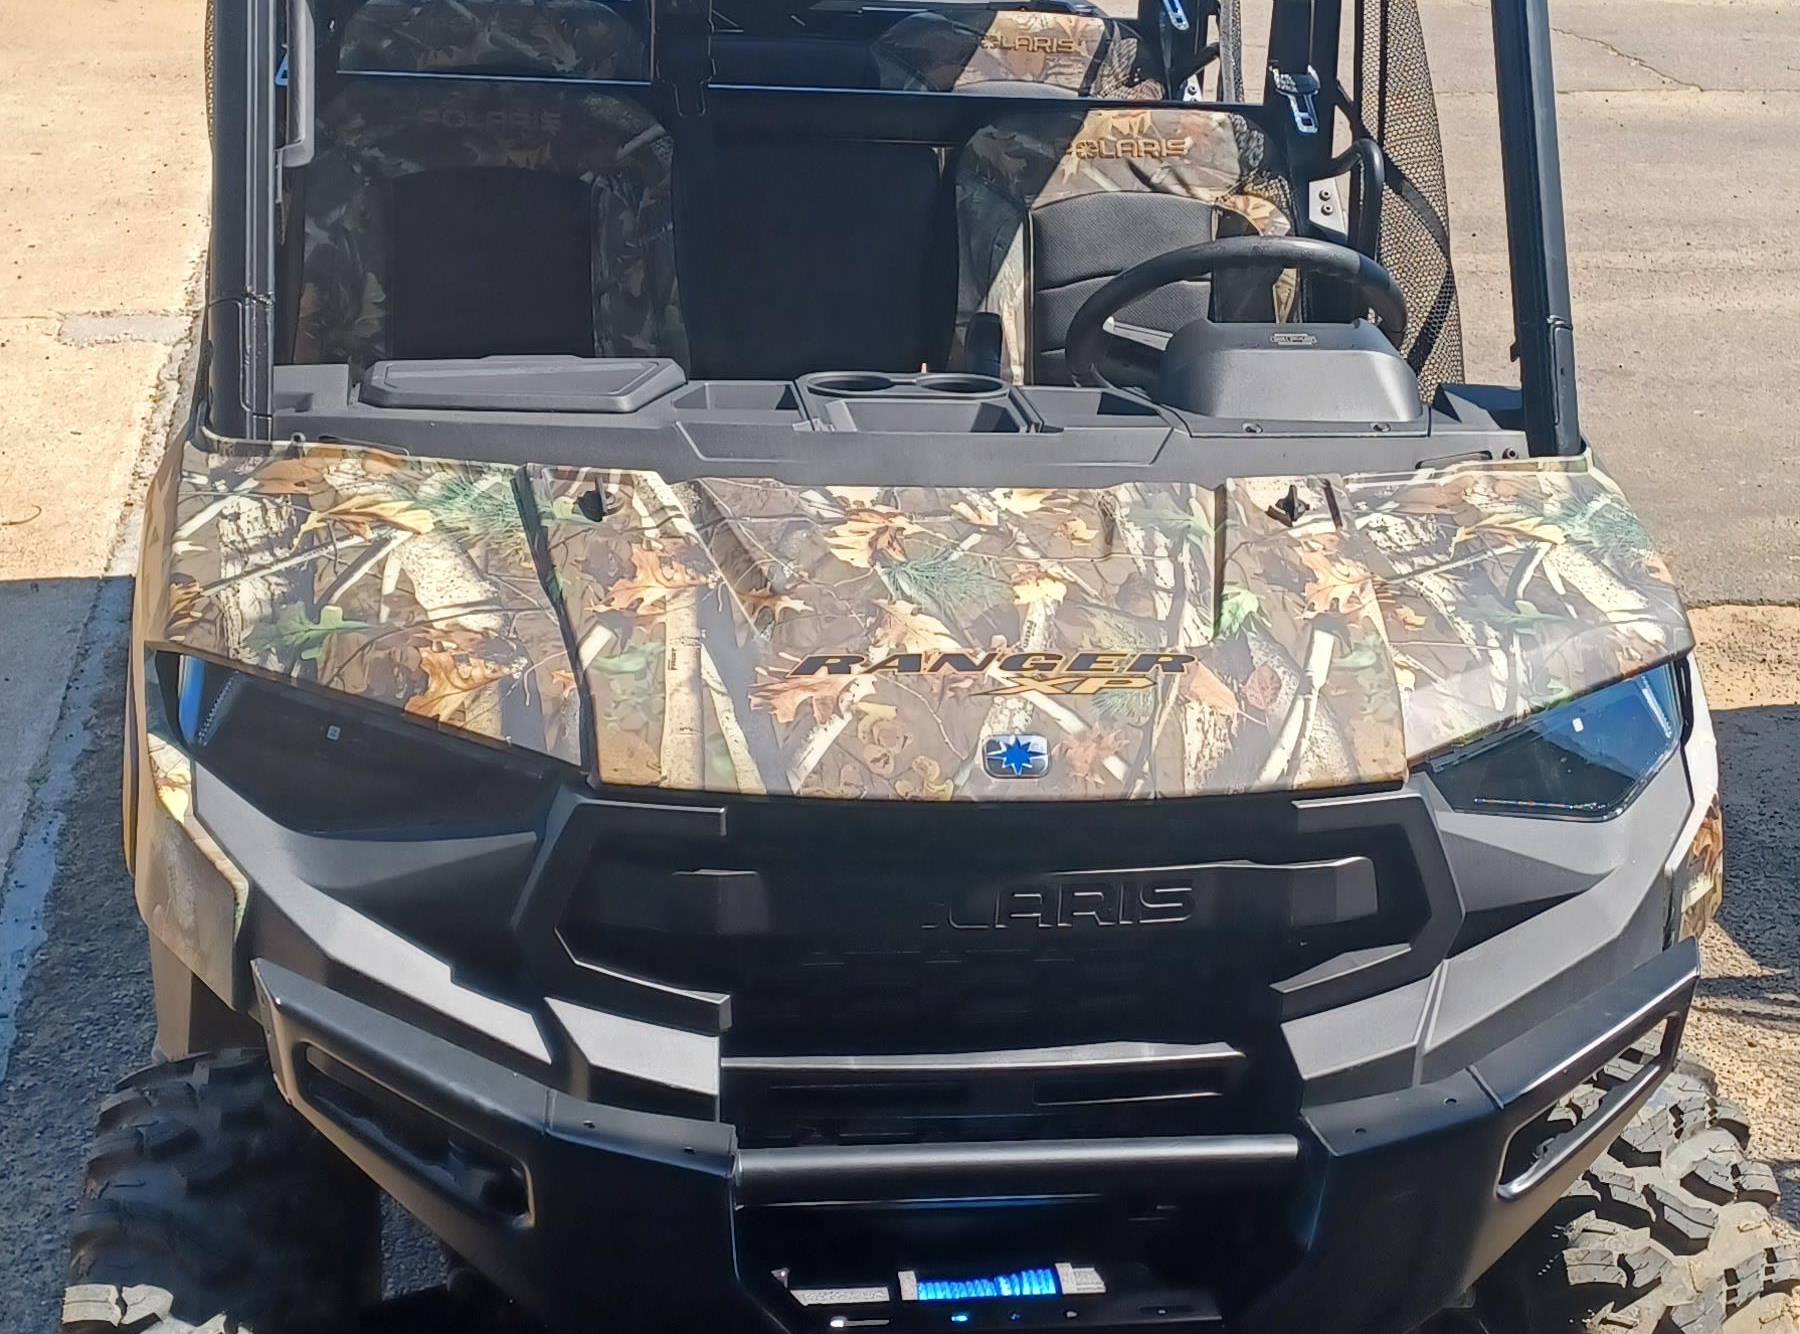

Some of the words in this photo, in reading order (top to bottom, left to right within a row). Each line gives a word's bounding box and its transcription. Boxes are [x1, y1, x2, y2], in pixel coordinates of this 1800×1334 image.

[979, 34, 1076, 54] OLARIS
[785, 650, 1200, 678] RANGER
[969, 675, 1159, 697] XP
[920, 880, 1196, 930] LARIS
